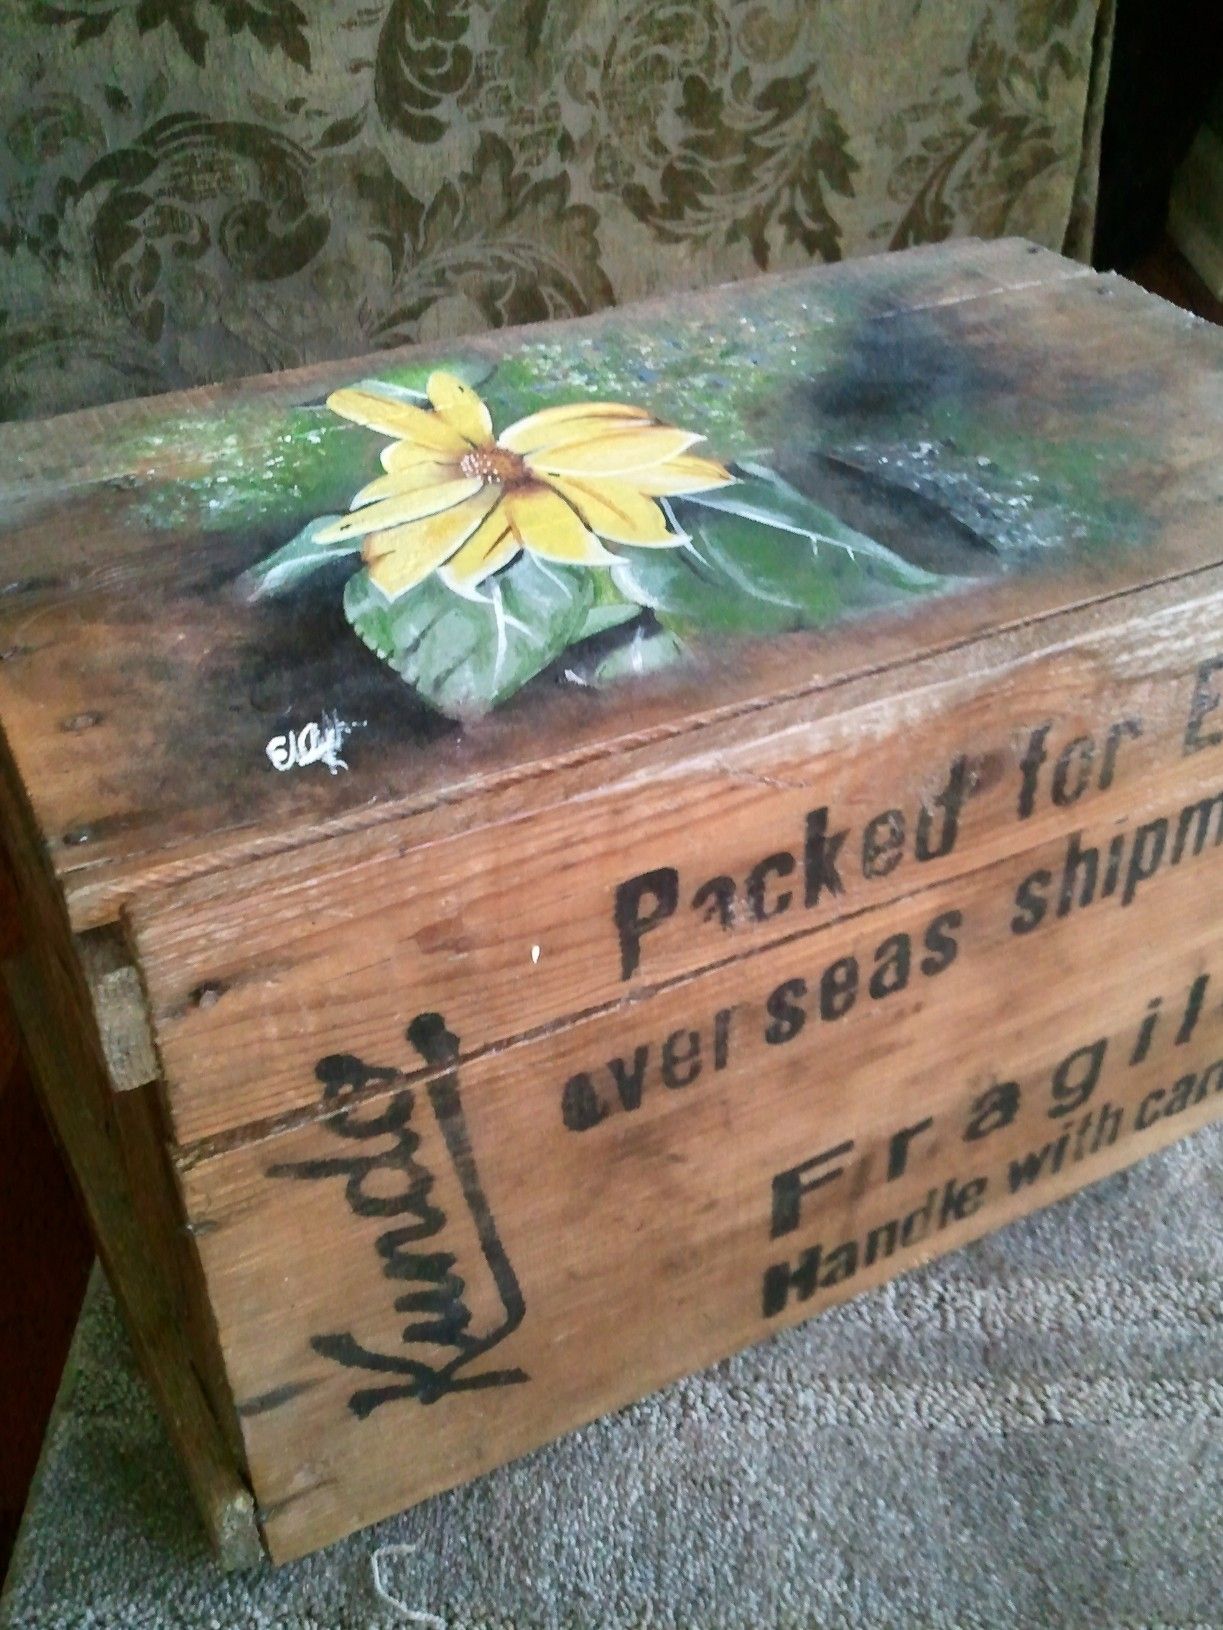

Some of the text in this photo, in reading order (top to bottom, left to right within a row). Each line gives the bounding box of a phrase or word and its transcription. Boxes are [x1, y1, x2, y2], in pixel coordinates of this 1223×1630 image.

[613, 654, 1223, 982] Packed for E
[1010, 788, 1223, 936] shipm
[761, 1176, 988, 1319] Handle
[1007, 1101, 1125, 1194] with
[771, 973, 1223, 1240] Fragil
